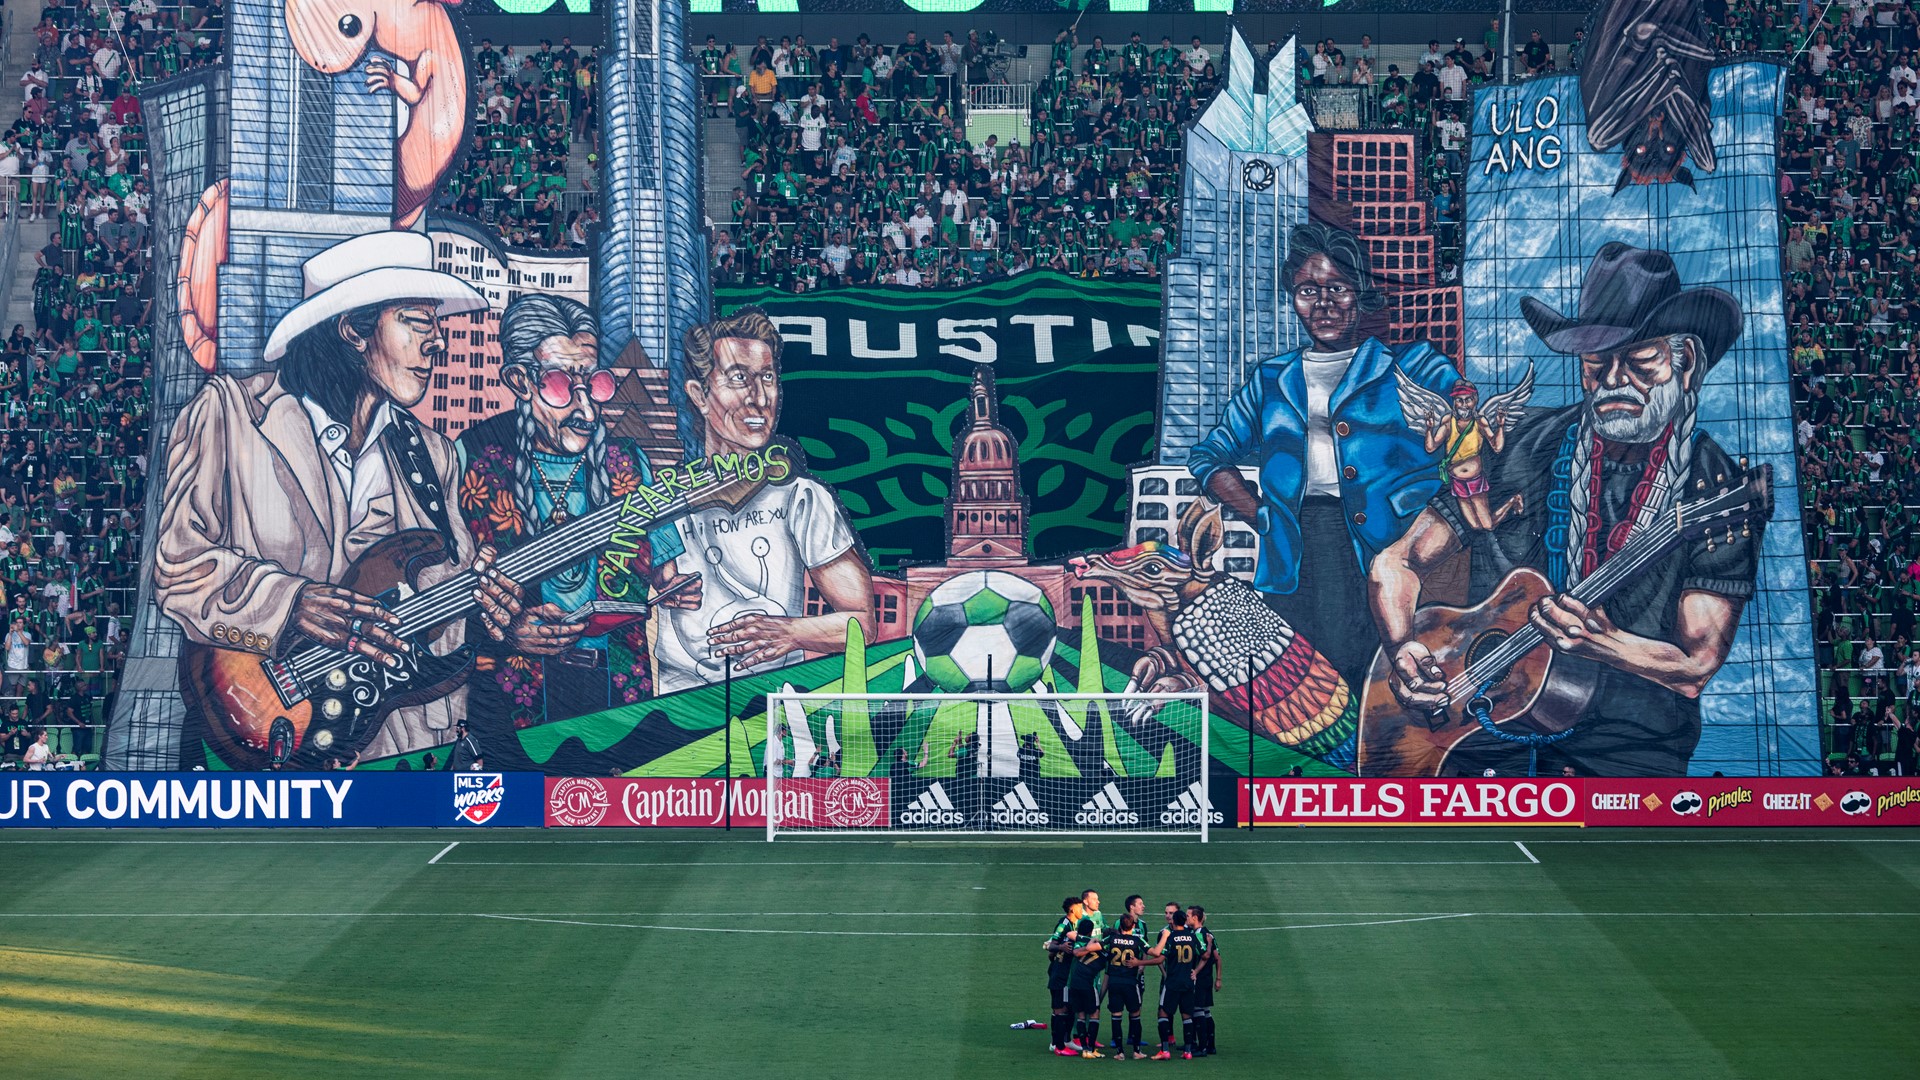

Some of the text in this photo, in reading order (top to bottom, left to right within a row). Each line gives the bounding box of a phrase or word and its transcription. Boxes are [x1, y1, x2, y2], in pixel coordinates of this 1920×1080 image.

[1492, 96, 1558, 135] ULO
[1484, 135, 1561, 175] ANG
[1892, 283, 1904, 291] YETI
[599, 445, 789, 598] CANTAREMOS
[713, 518, 740, 535] HOW
[745, 510, 768, 529] ARE
[767, 507, 789, 525] YOU
[458, 777, 483, 788] MLS
[558, 779, 596, 796] CAPTAIN MORGAN
[66, 779, 353, 820] COMMUNITY
[454, 786, 504, 808] WORKS
[567, 792, 591, 813] CM
[622, 780, 813, 826] Captain Morgan
[1245, 782, 1576, 817] WELLS FARGO
[1707, 786, 1752, 817] Pringles
[1876, 786, 1920, 817] Pringles
[564, 810, 599, 824] RUM COMPANY
[901, 808, 964, 824] adidas
[1075, 808, 1139, 824] adidas
[1111, 948, 1135, 966] 20
[1176, 945, 1192, 963] 10
